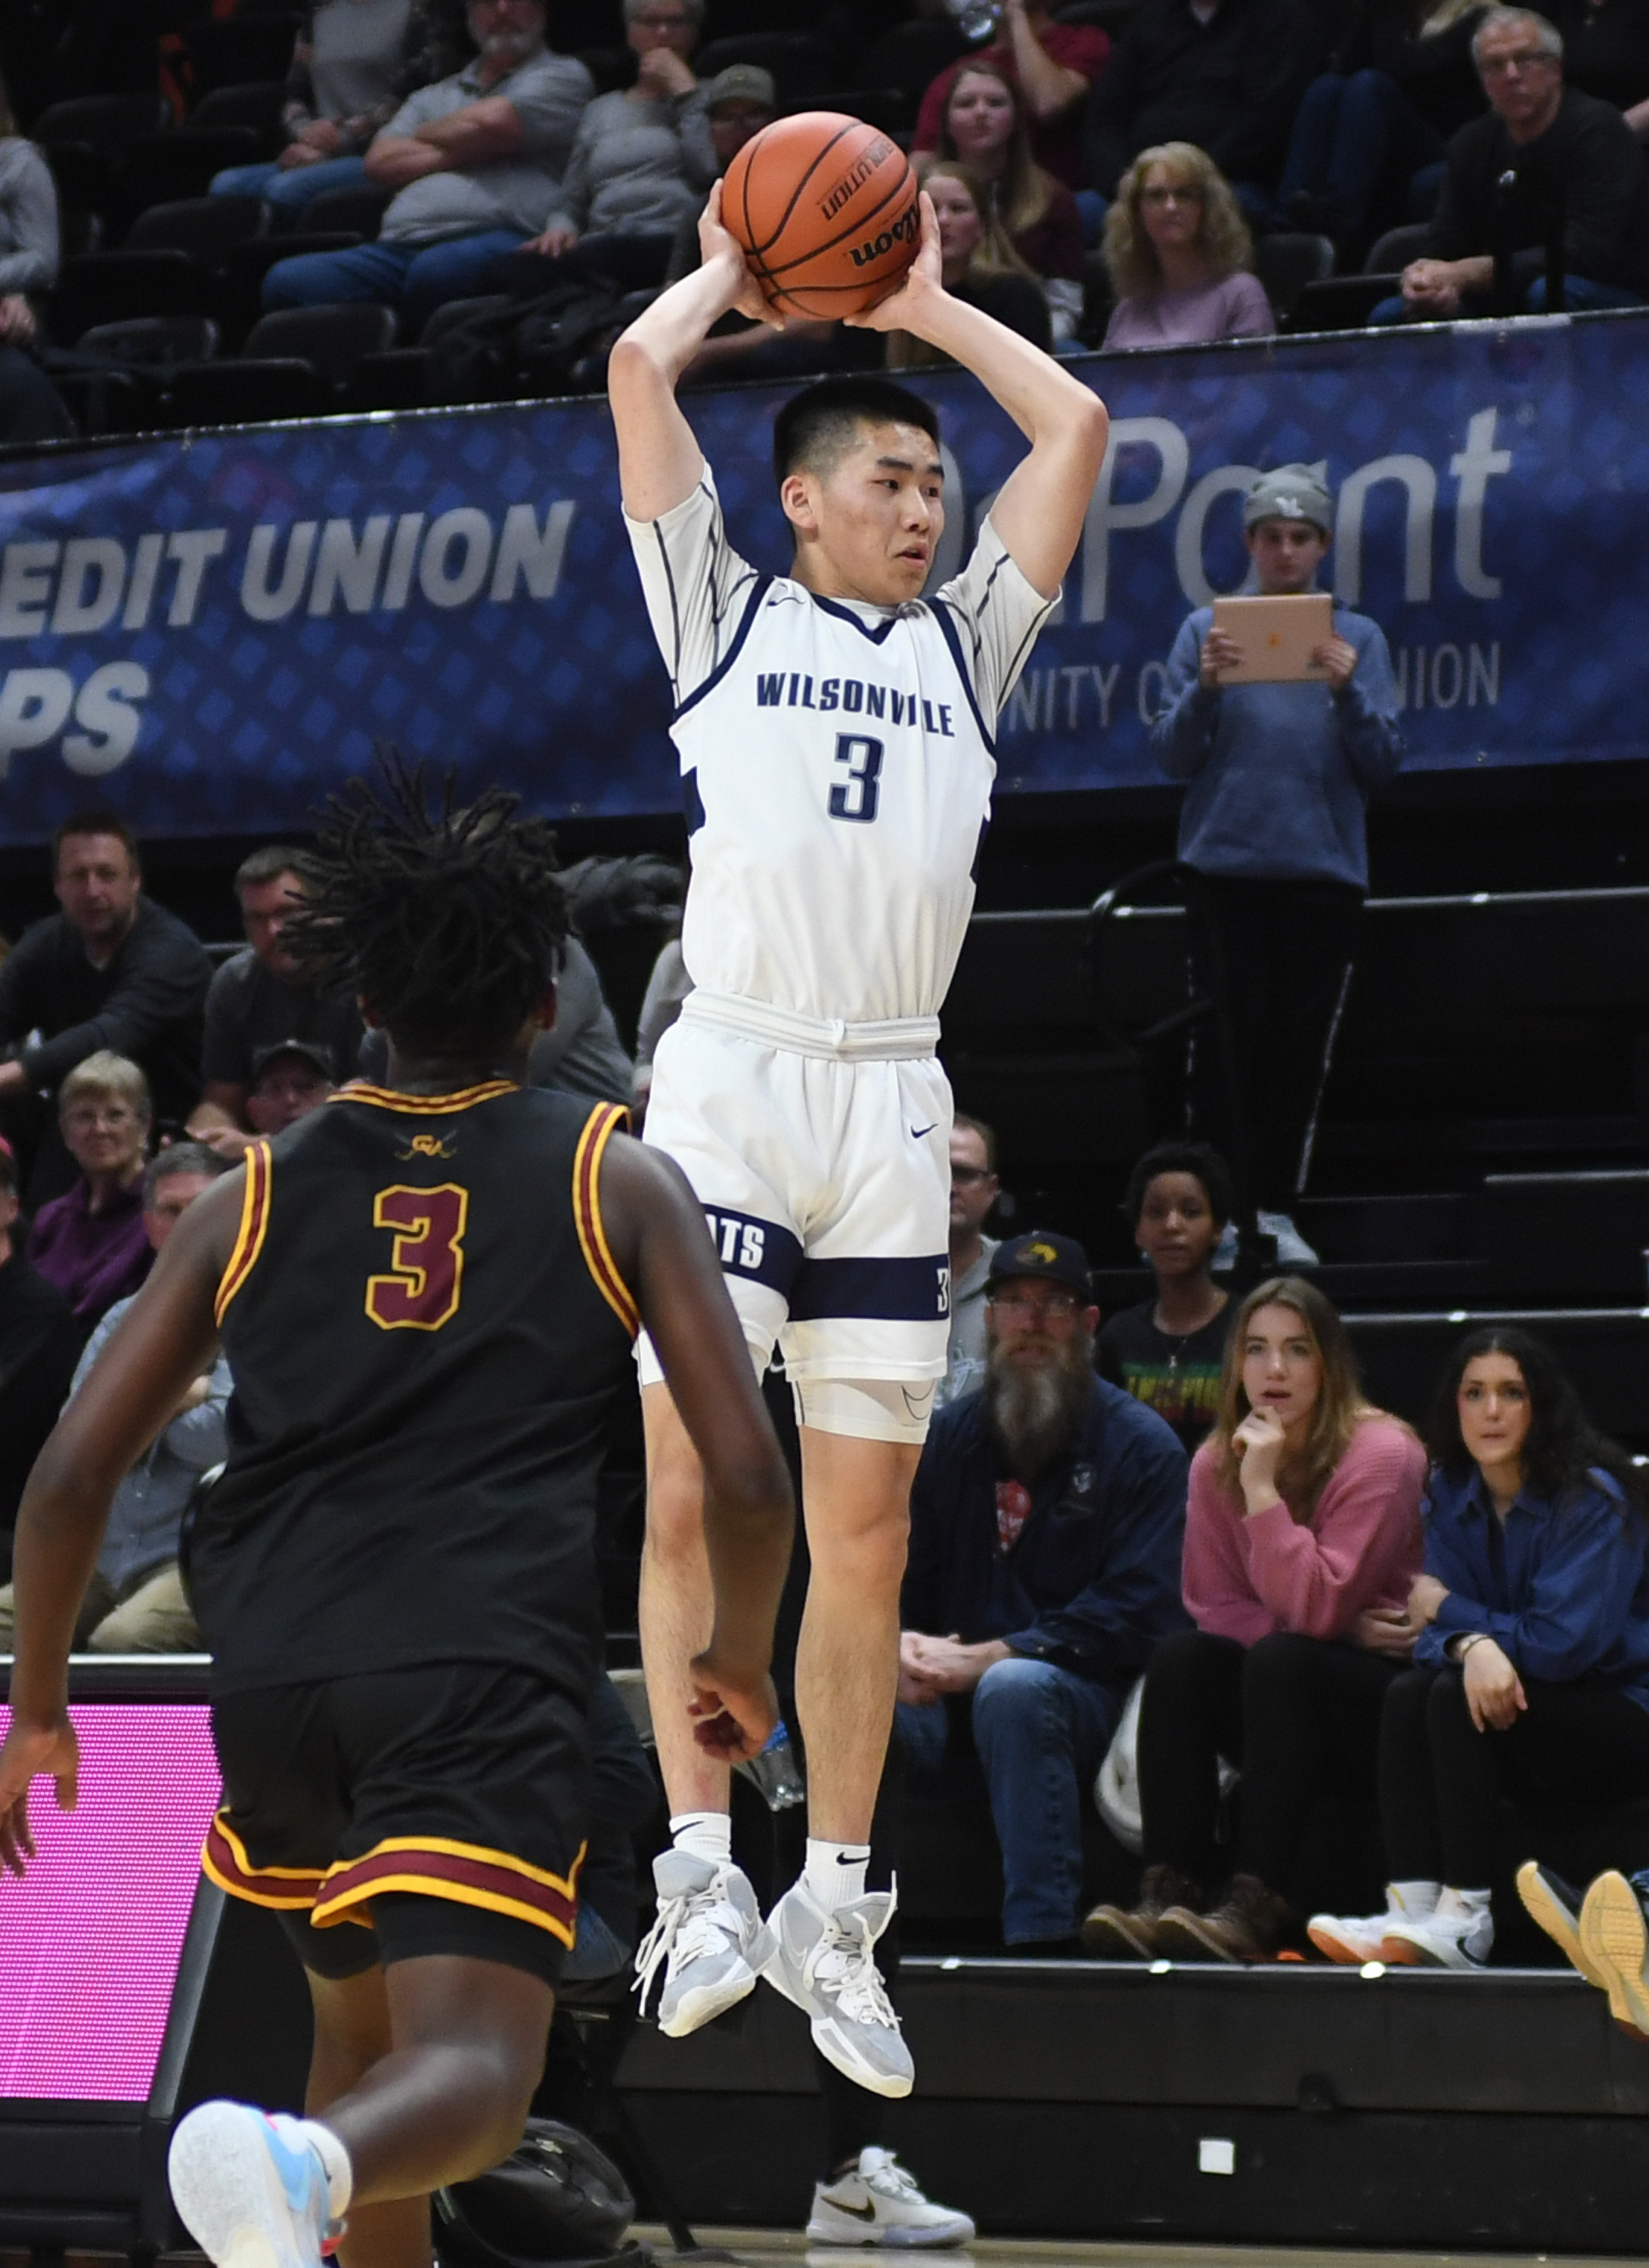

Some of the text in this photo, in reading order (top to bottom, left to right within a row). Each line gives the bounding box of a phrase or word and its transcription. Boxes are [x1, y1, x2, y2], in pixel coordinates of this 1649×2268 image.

[821, 140, 896, 222] LUTION
[848, 203, 919, 267] ilson
[240, 499, 577, 621] UNION
[756, 672, 956, 738] WILSONVILE
[826, 731, 885, 824] 3
[364, 1182, 469, 1331] 3
